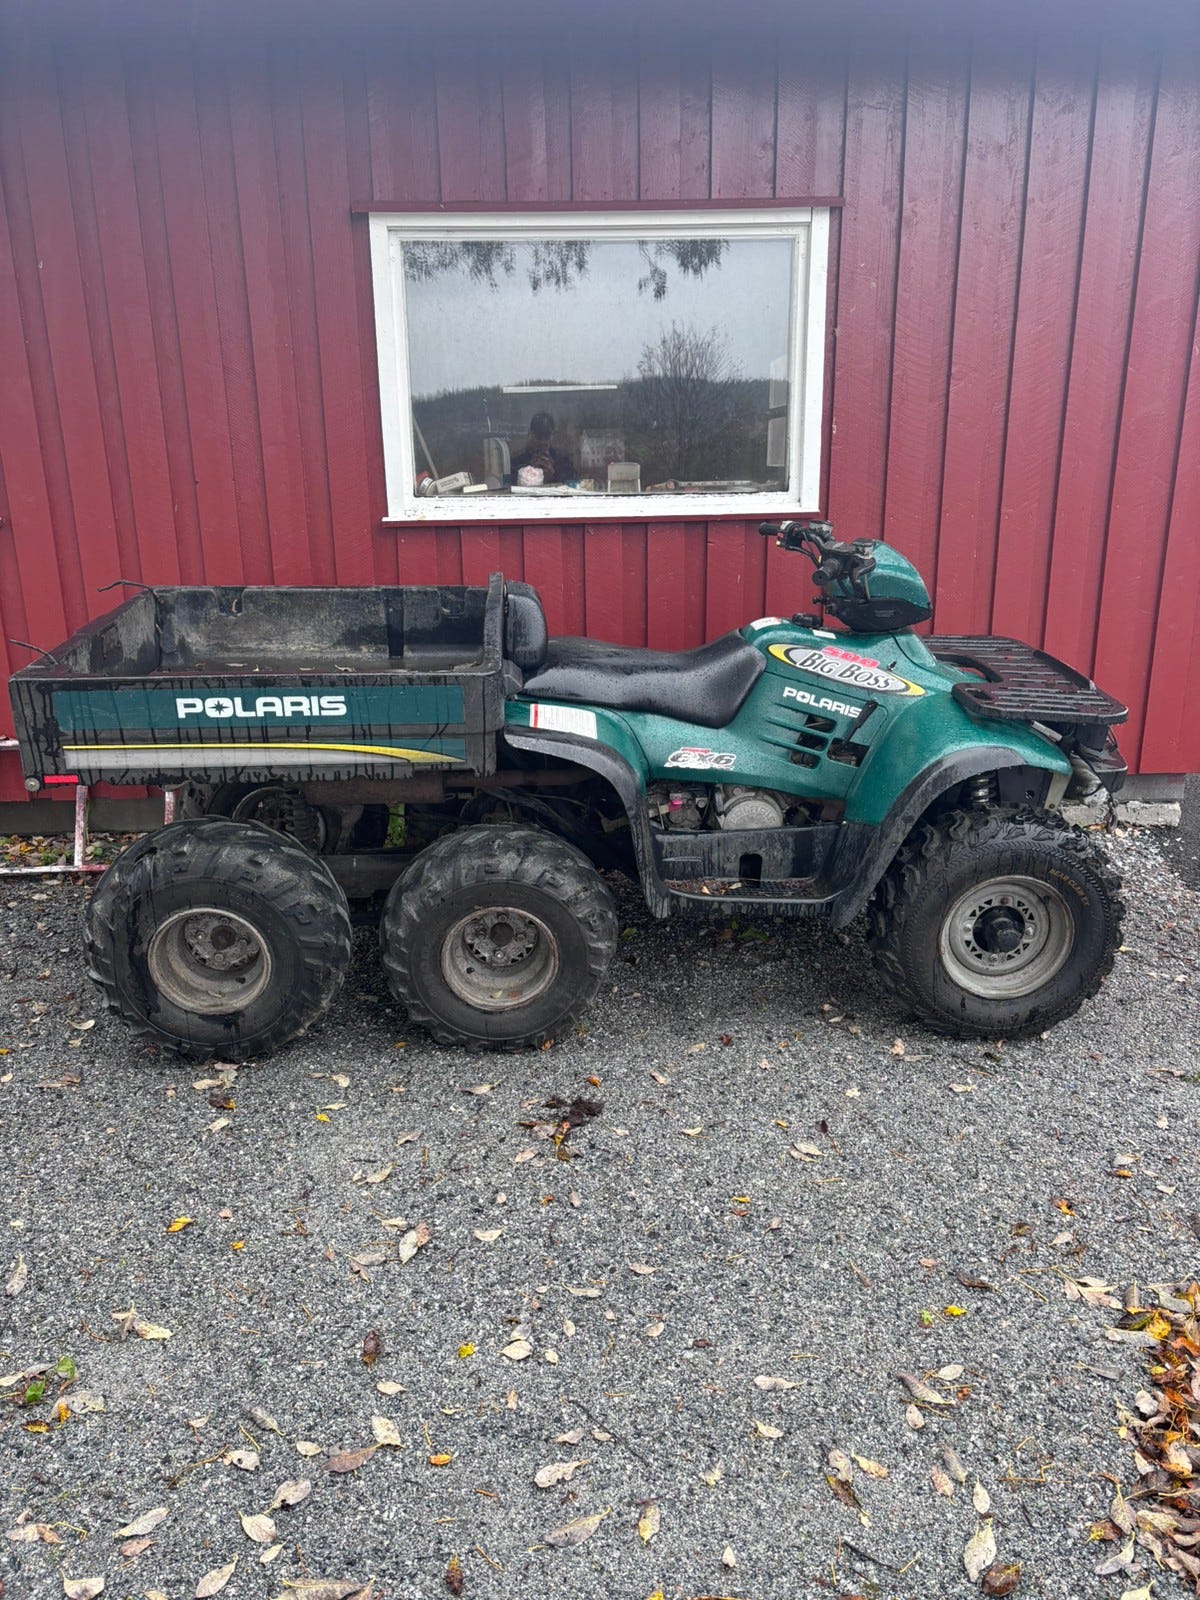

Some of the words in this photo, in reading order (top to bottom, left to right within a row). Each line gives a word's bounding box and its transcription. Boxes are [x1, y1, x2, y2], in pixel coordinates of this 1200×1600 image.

[800, 652, 838, 674] BIG
[838, 664, 895, 689] BOSS
[821, 646, 879, 669] 500
[176, 695, 347, 719] POLARIS
[783, 686, 862, 718] POLARIS
